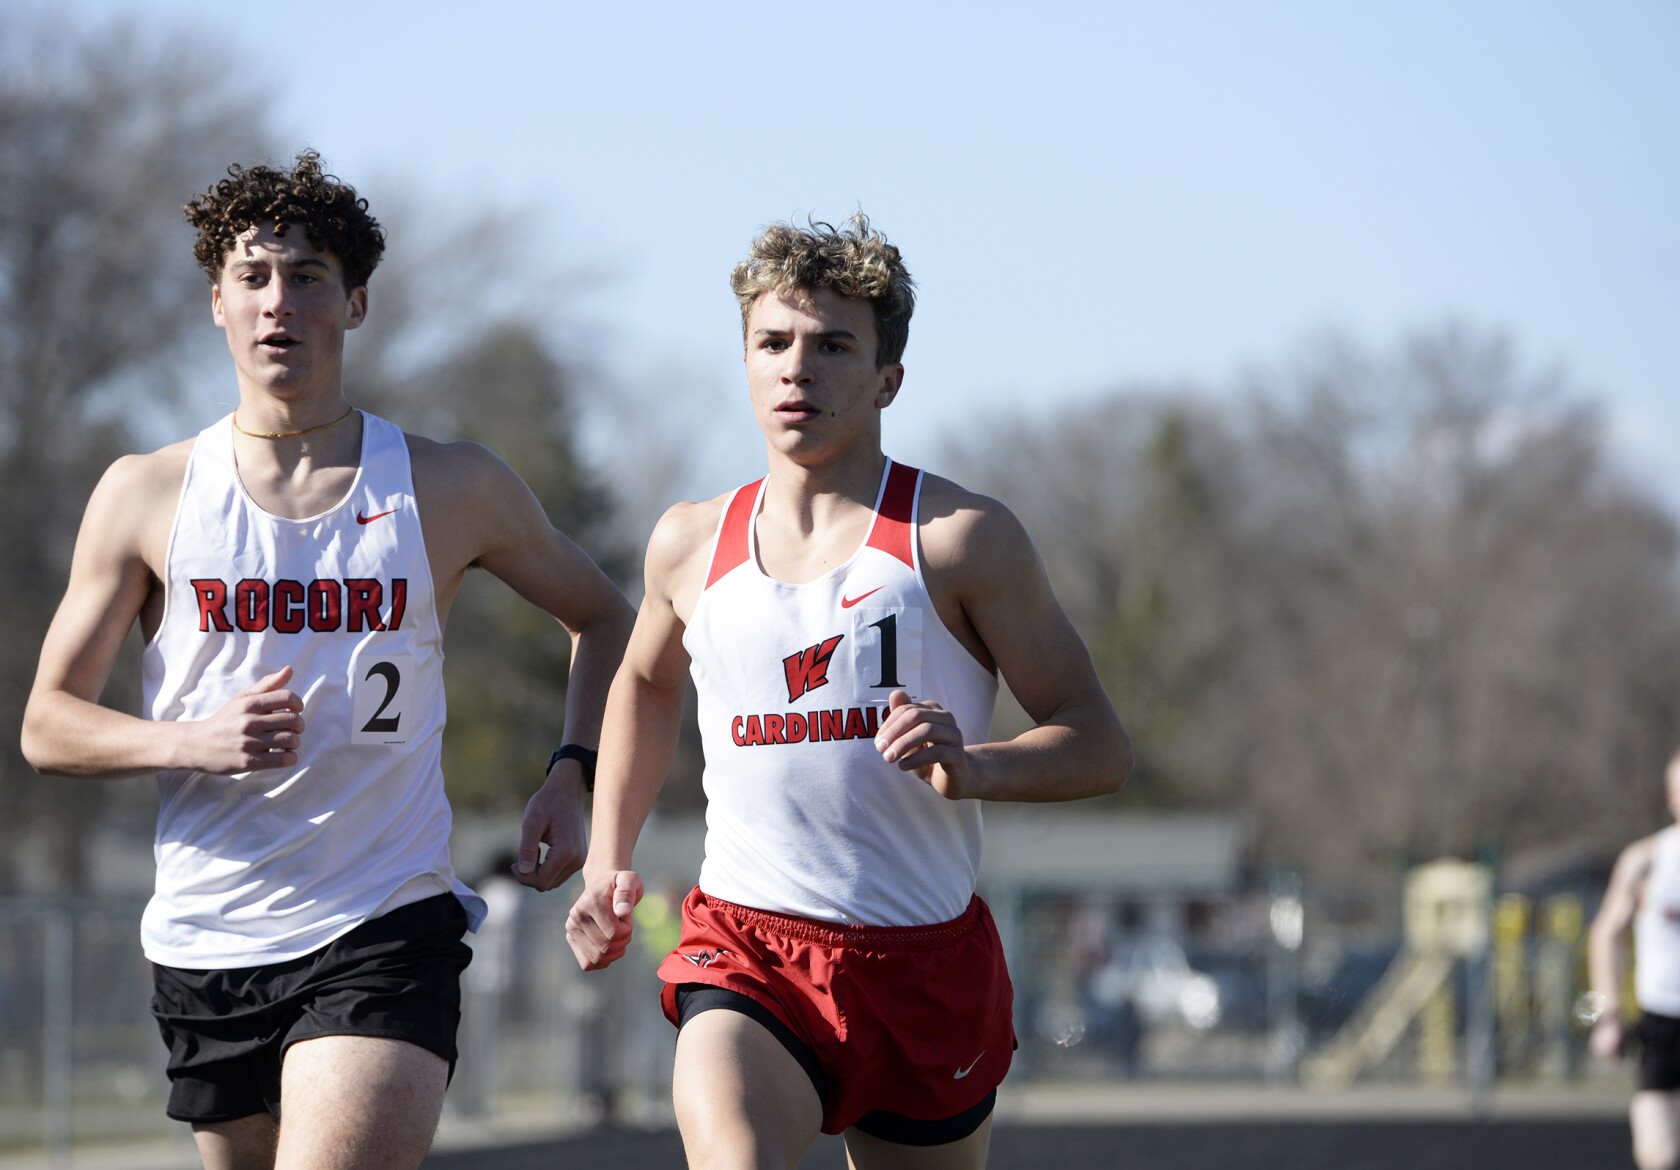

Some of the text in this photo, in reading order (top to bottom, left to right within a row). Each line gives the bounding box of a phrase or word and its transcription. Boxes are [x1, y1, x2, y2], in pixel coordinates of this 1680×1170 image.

[190, 578, 408, 634] ROCORI
[868, 613, 906, 688] 1
[361, 661, 402, 733] 2
[731, 706, 892, 747] CARDINAL
